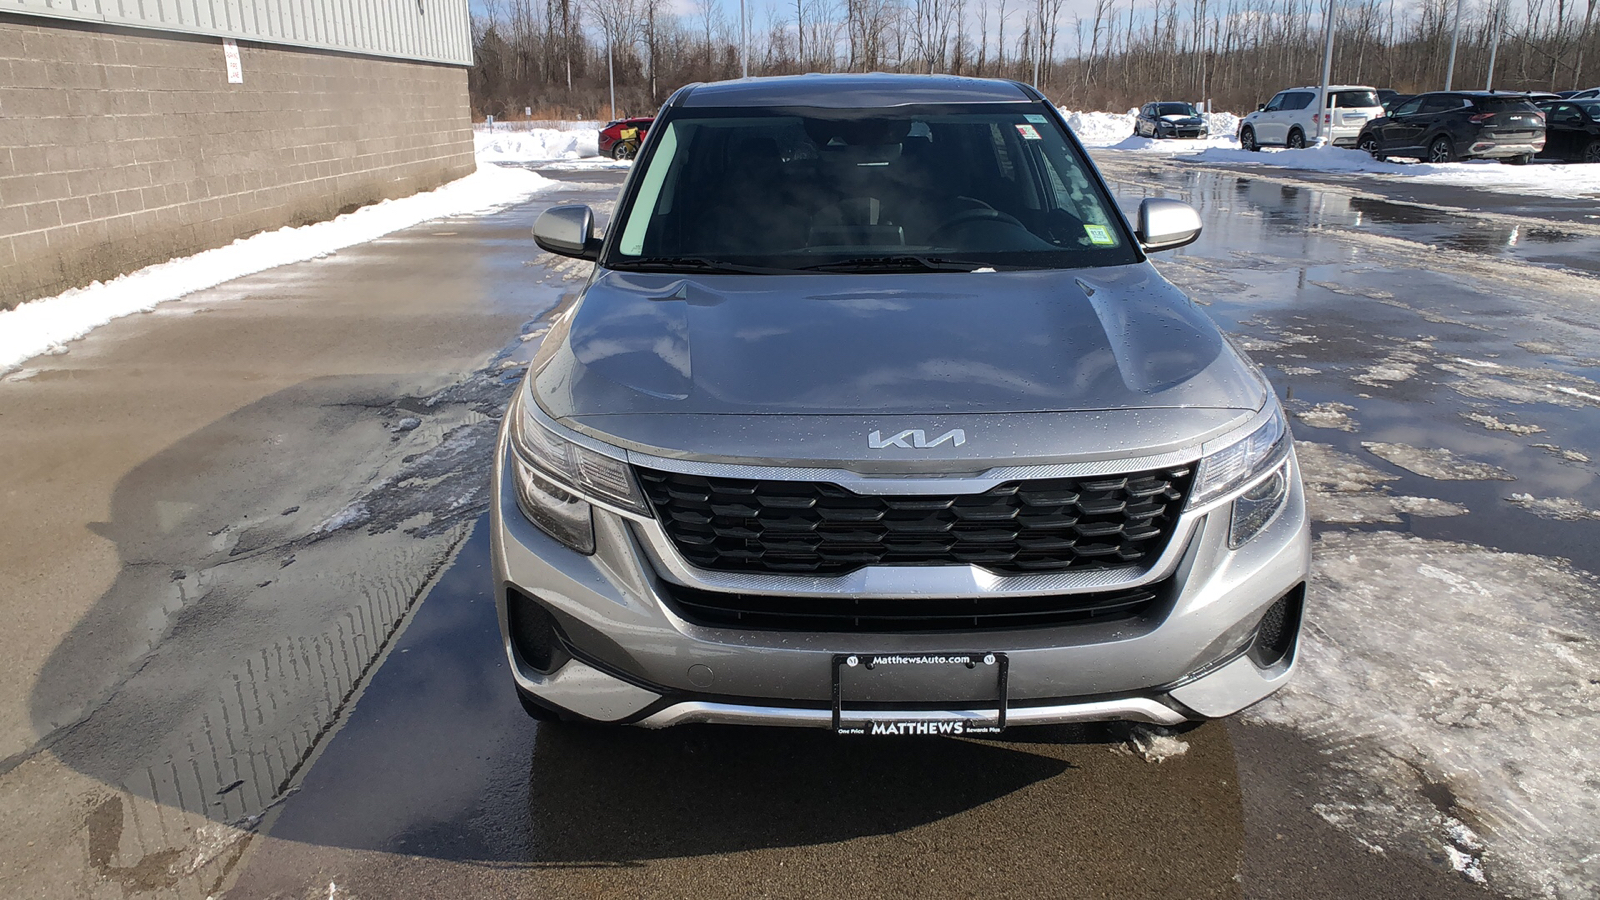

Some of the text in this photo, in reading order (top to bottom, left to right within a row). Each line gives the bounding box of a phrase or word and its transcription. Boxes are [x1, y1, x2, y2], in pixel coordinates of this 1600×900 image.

[868, 429, 966, 449] KIA
[873, 655, 970, 665] MatthewsAuto.com
[871, 721, 964, 735] MATTHEWS
